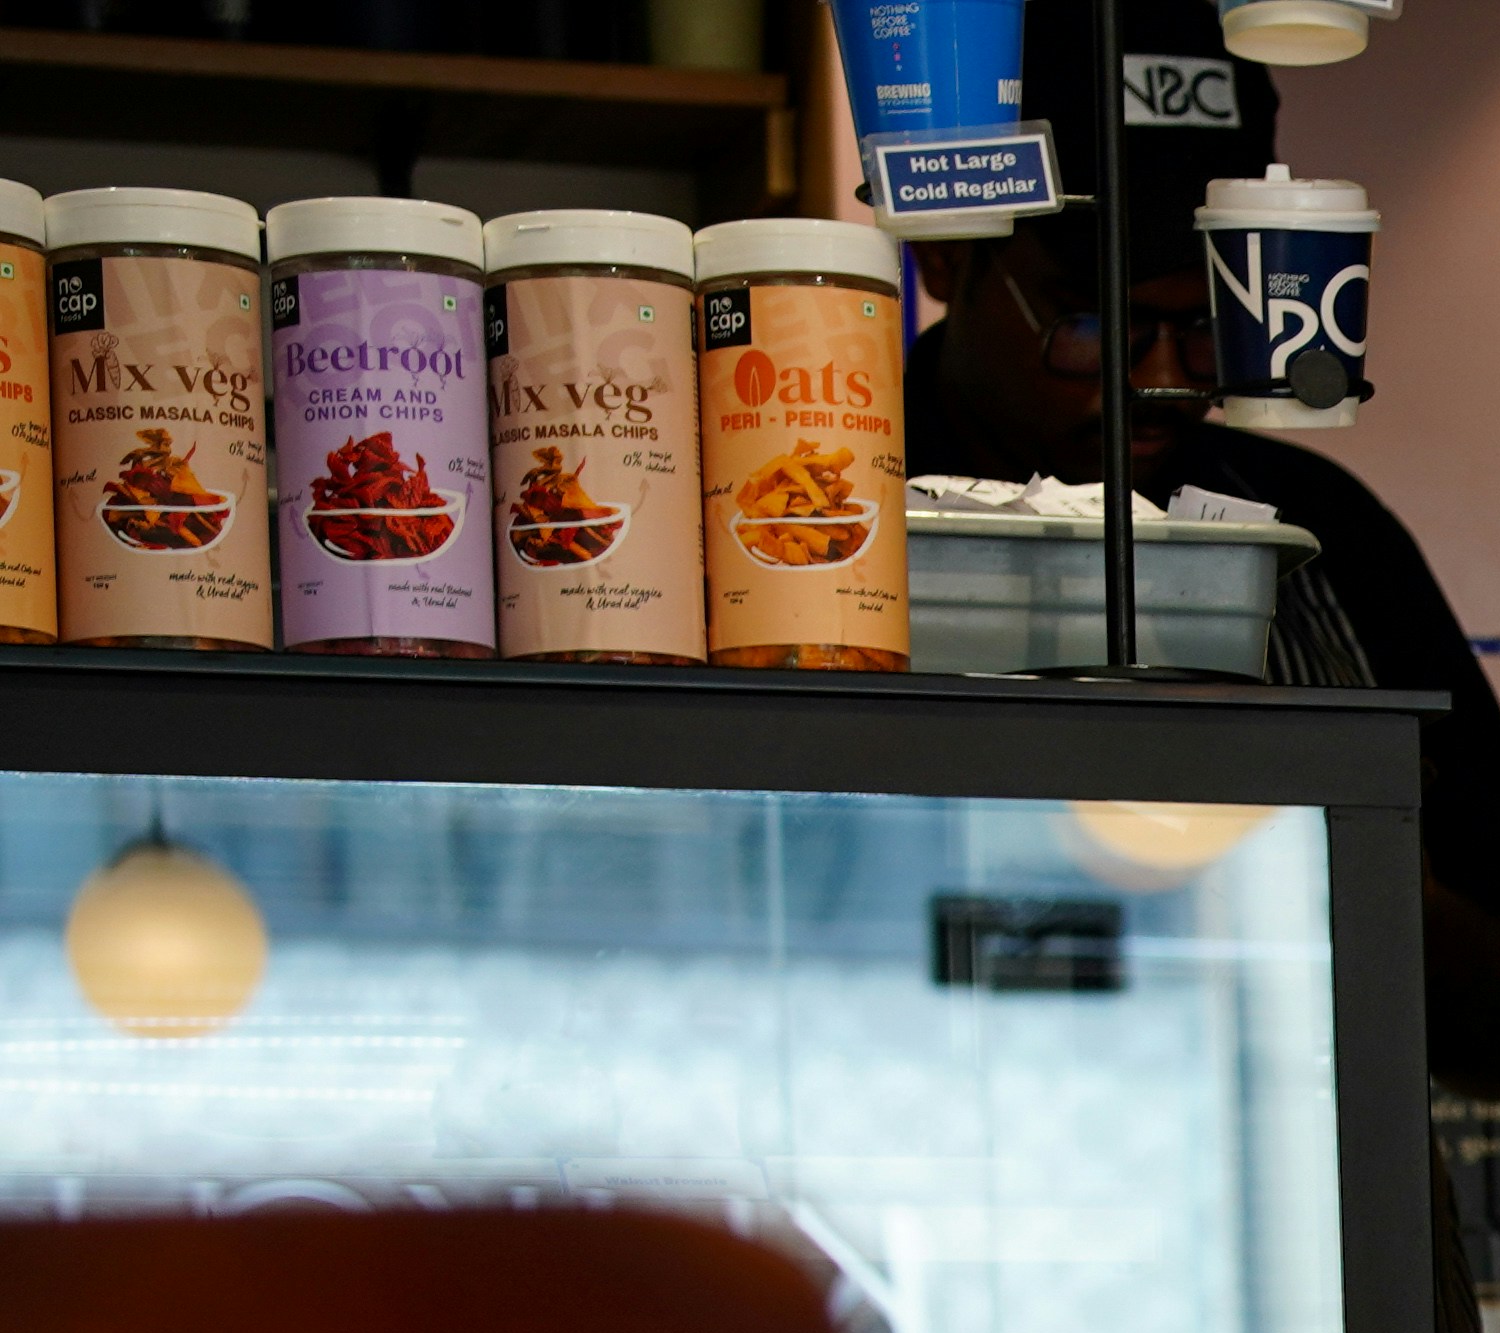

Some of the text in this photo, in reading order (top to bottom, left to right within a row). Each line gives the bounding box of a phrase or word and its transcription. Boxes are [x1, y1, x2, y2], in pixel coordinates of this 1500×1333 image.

[910, 152, 1016, 173] Hot Large
[900, 177, 1037, 201] Cold Regular
[59, 276, 82, 295] no
[59, 293, 97, 316] cap
[274, 296, 296, 314] cap
[709, 297, 733, 314] no
[710, 312, 746, 333] cap
[286, 341, 466, 385] Beetroot
[173, 362, 251, 414] veg
[734, 350, 873, 409] Oats
[309, 388, 437, 404] CREAM AND
[564, 380, 653, 423] veg
[69, 405, 255, 432] CLASSIC MASALA CHIPS
[305, 405, 444, 423] ONION CHIPS
[720, 412, 761, 432] PERI
[785, 411, 833, 428] PERI
[842, 412, 892, 436] CHIPS
[535, 424, 659, 441] MASALA CHIPS
